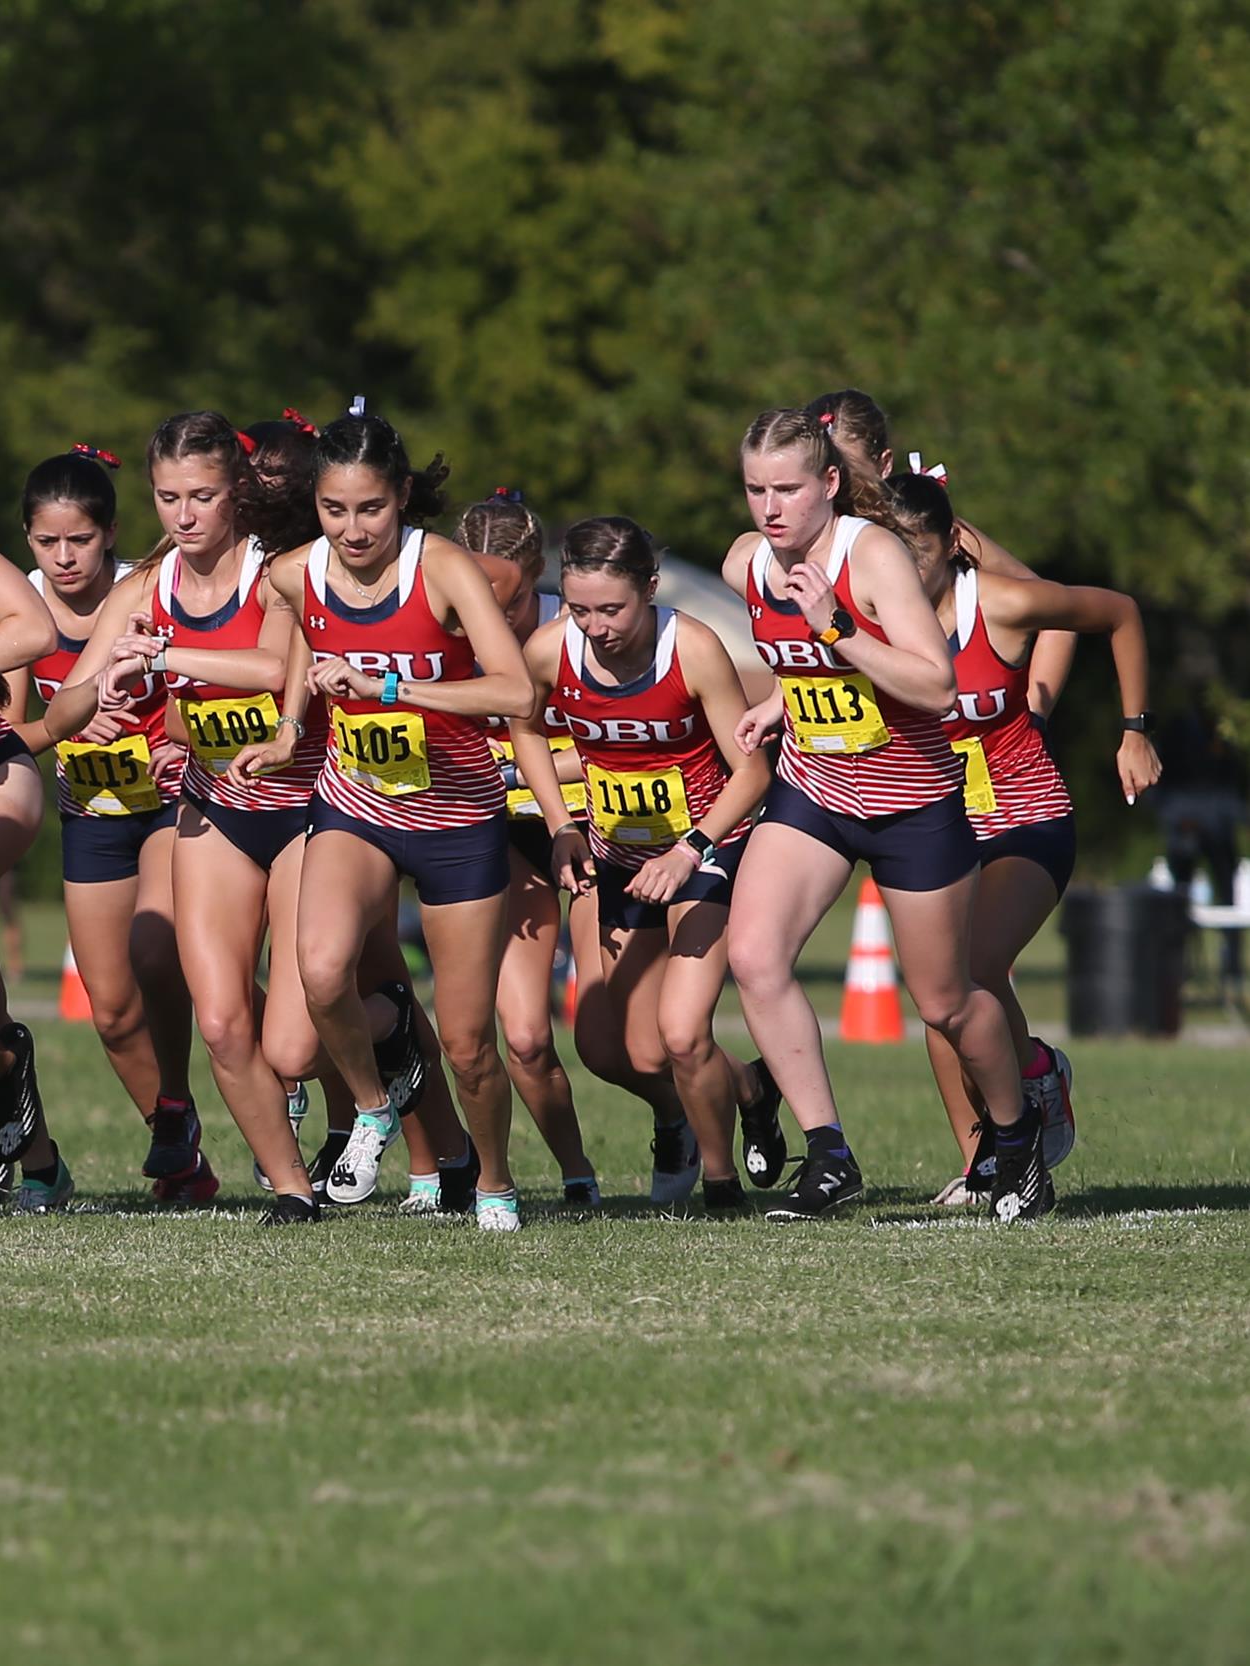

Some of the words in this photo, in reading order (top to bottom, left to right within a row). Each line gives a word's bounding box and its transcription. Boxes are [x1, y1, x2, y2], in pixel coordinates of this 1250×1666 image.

[792, 684, 864, 724] 1113
[189, 707, 268, 748] 1109
[338, 720, 410, 765] 1105
[563, 712, 695, 743] DBU
[67, 749, 139, 787] 1115
[598, 779, 672, 817] 1118
